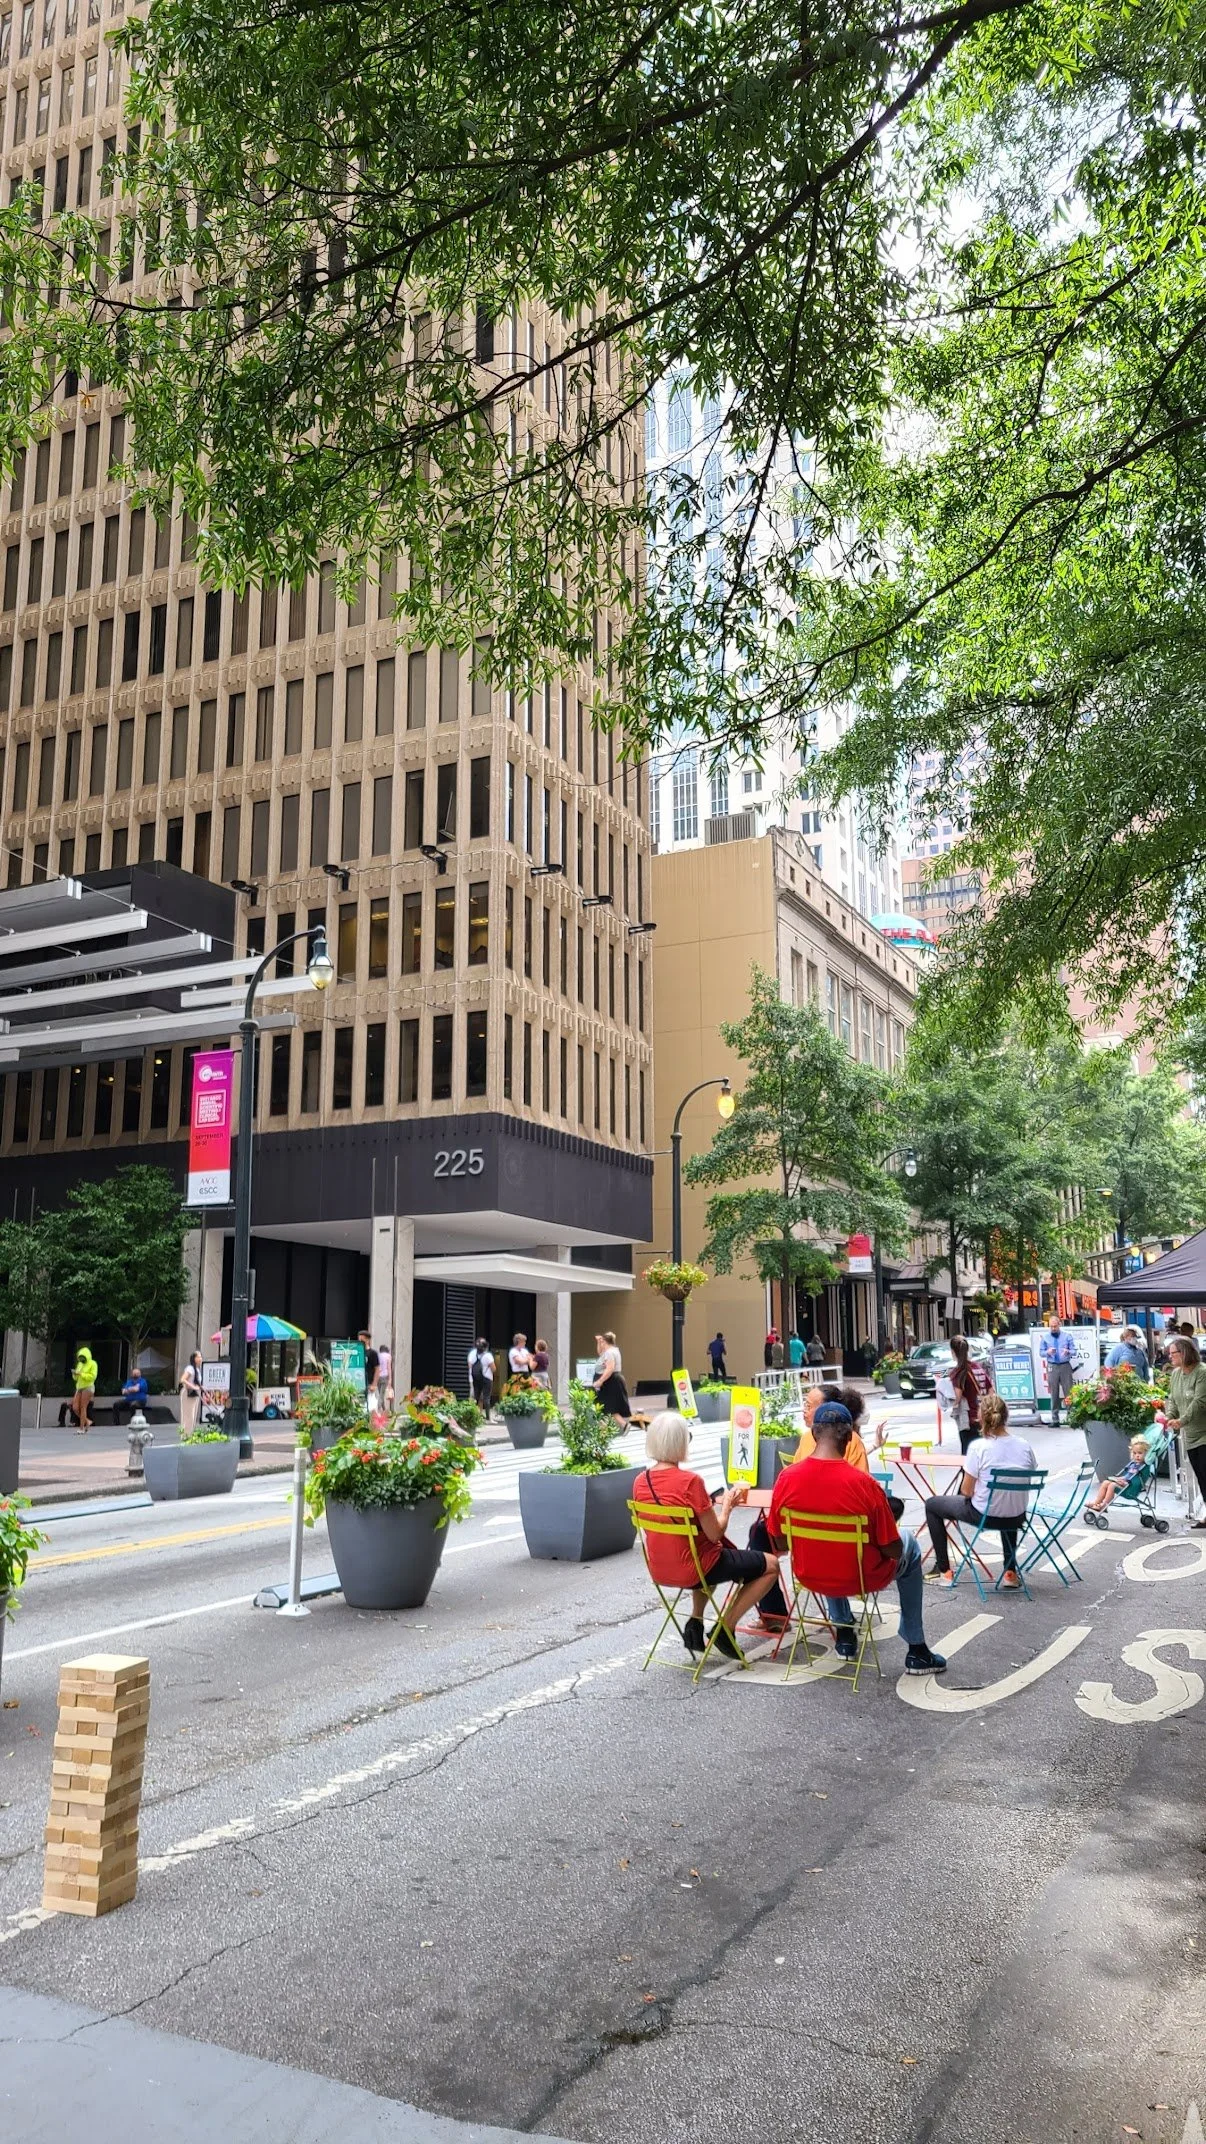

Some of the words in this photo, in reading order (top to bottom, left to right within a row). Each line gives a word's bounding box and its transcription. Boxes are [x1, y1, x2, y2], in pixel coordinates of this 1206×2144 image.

[434, 1148, 484, 1176] 225
[208, 1368, 226, 1378] GREEN
[703, 1599, 1206, 1724] BUS
